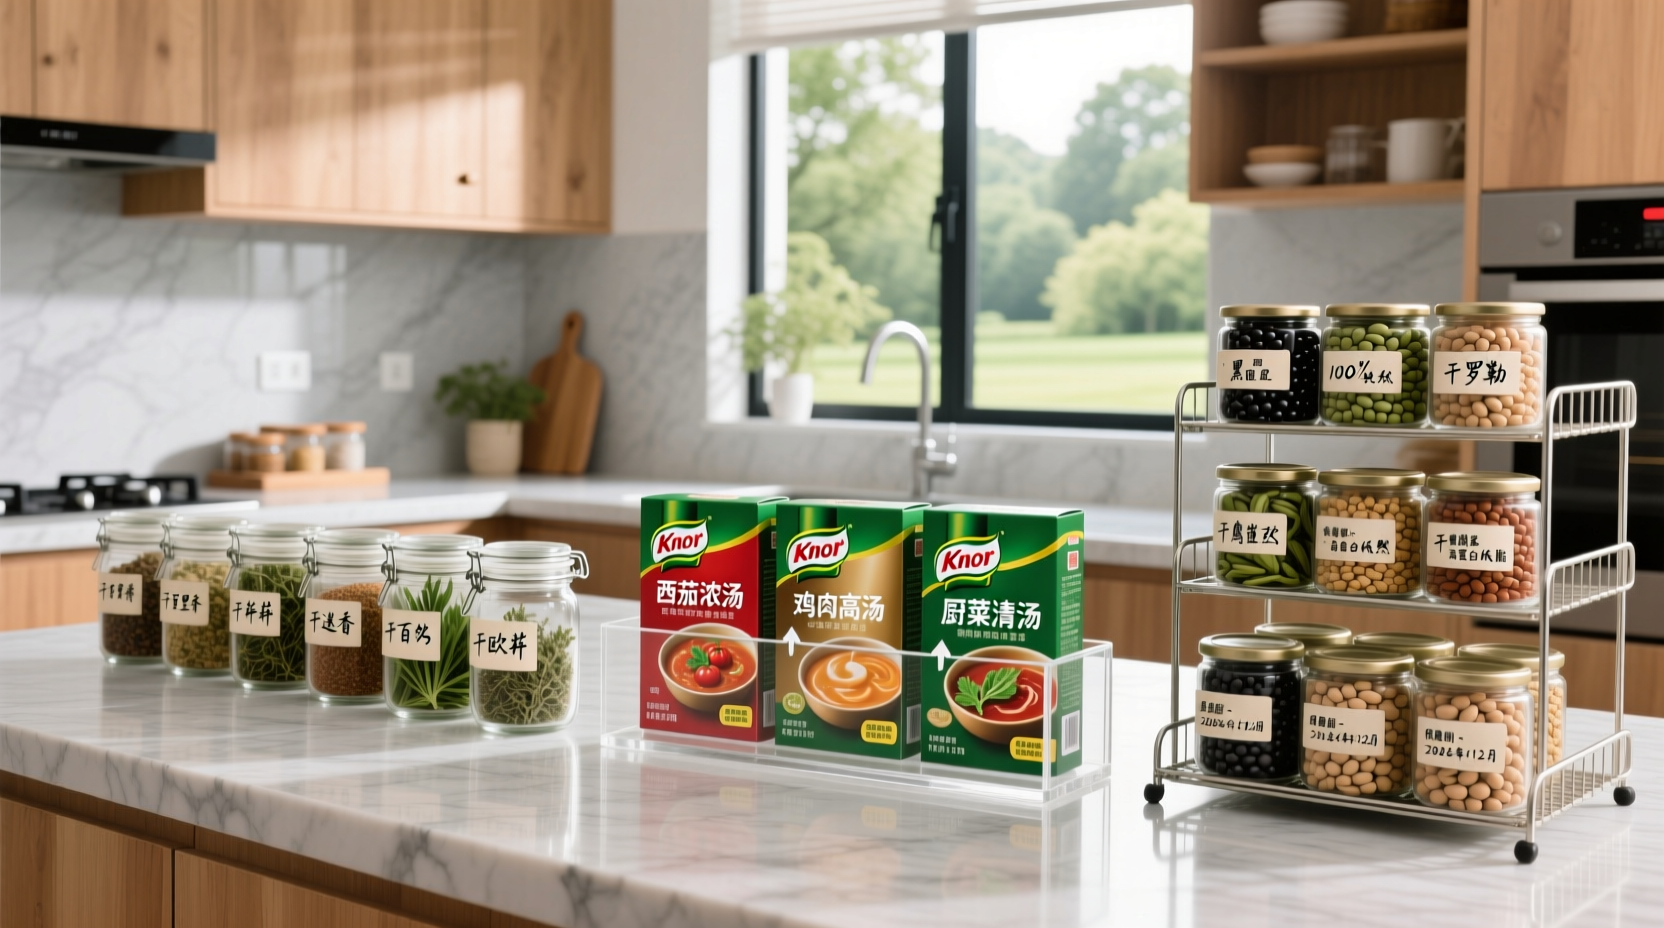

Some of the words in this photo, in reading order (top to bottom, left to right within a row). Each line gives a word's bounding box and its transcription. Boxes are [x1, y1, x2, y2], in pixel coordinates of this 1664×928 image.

[1444, 360, 1506, 386] 干罗勒
[657, 532, 703, 554] Knor
[793, 539, 844, 563] Knor
[941, 549, 995, 573] Knor
[657, 580, 744, 610] 西茄浓汤
[793, 591, 885, 622] 鸡肉高汤
[941, 598, 1042, 630] 厨菜清汤
